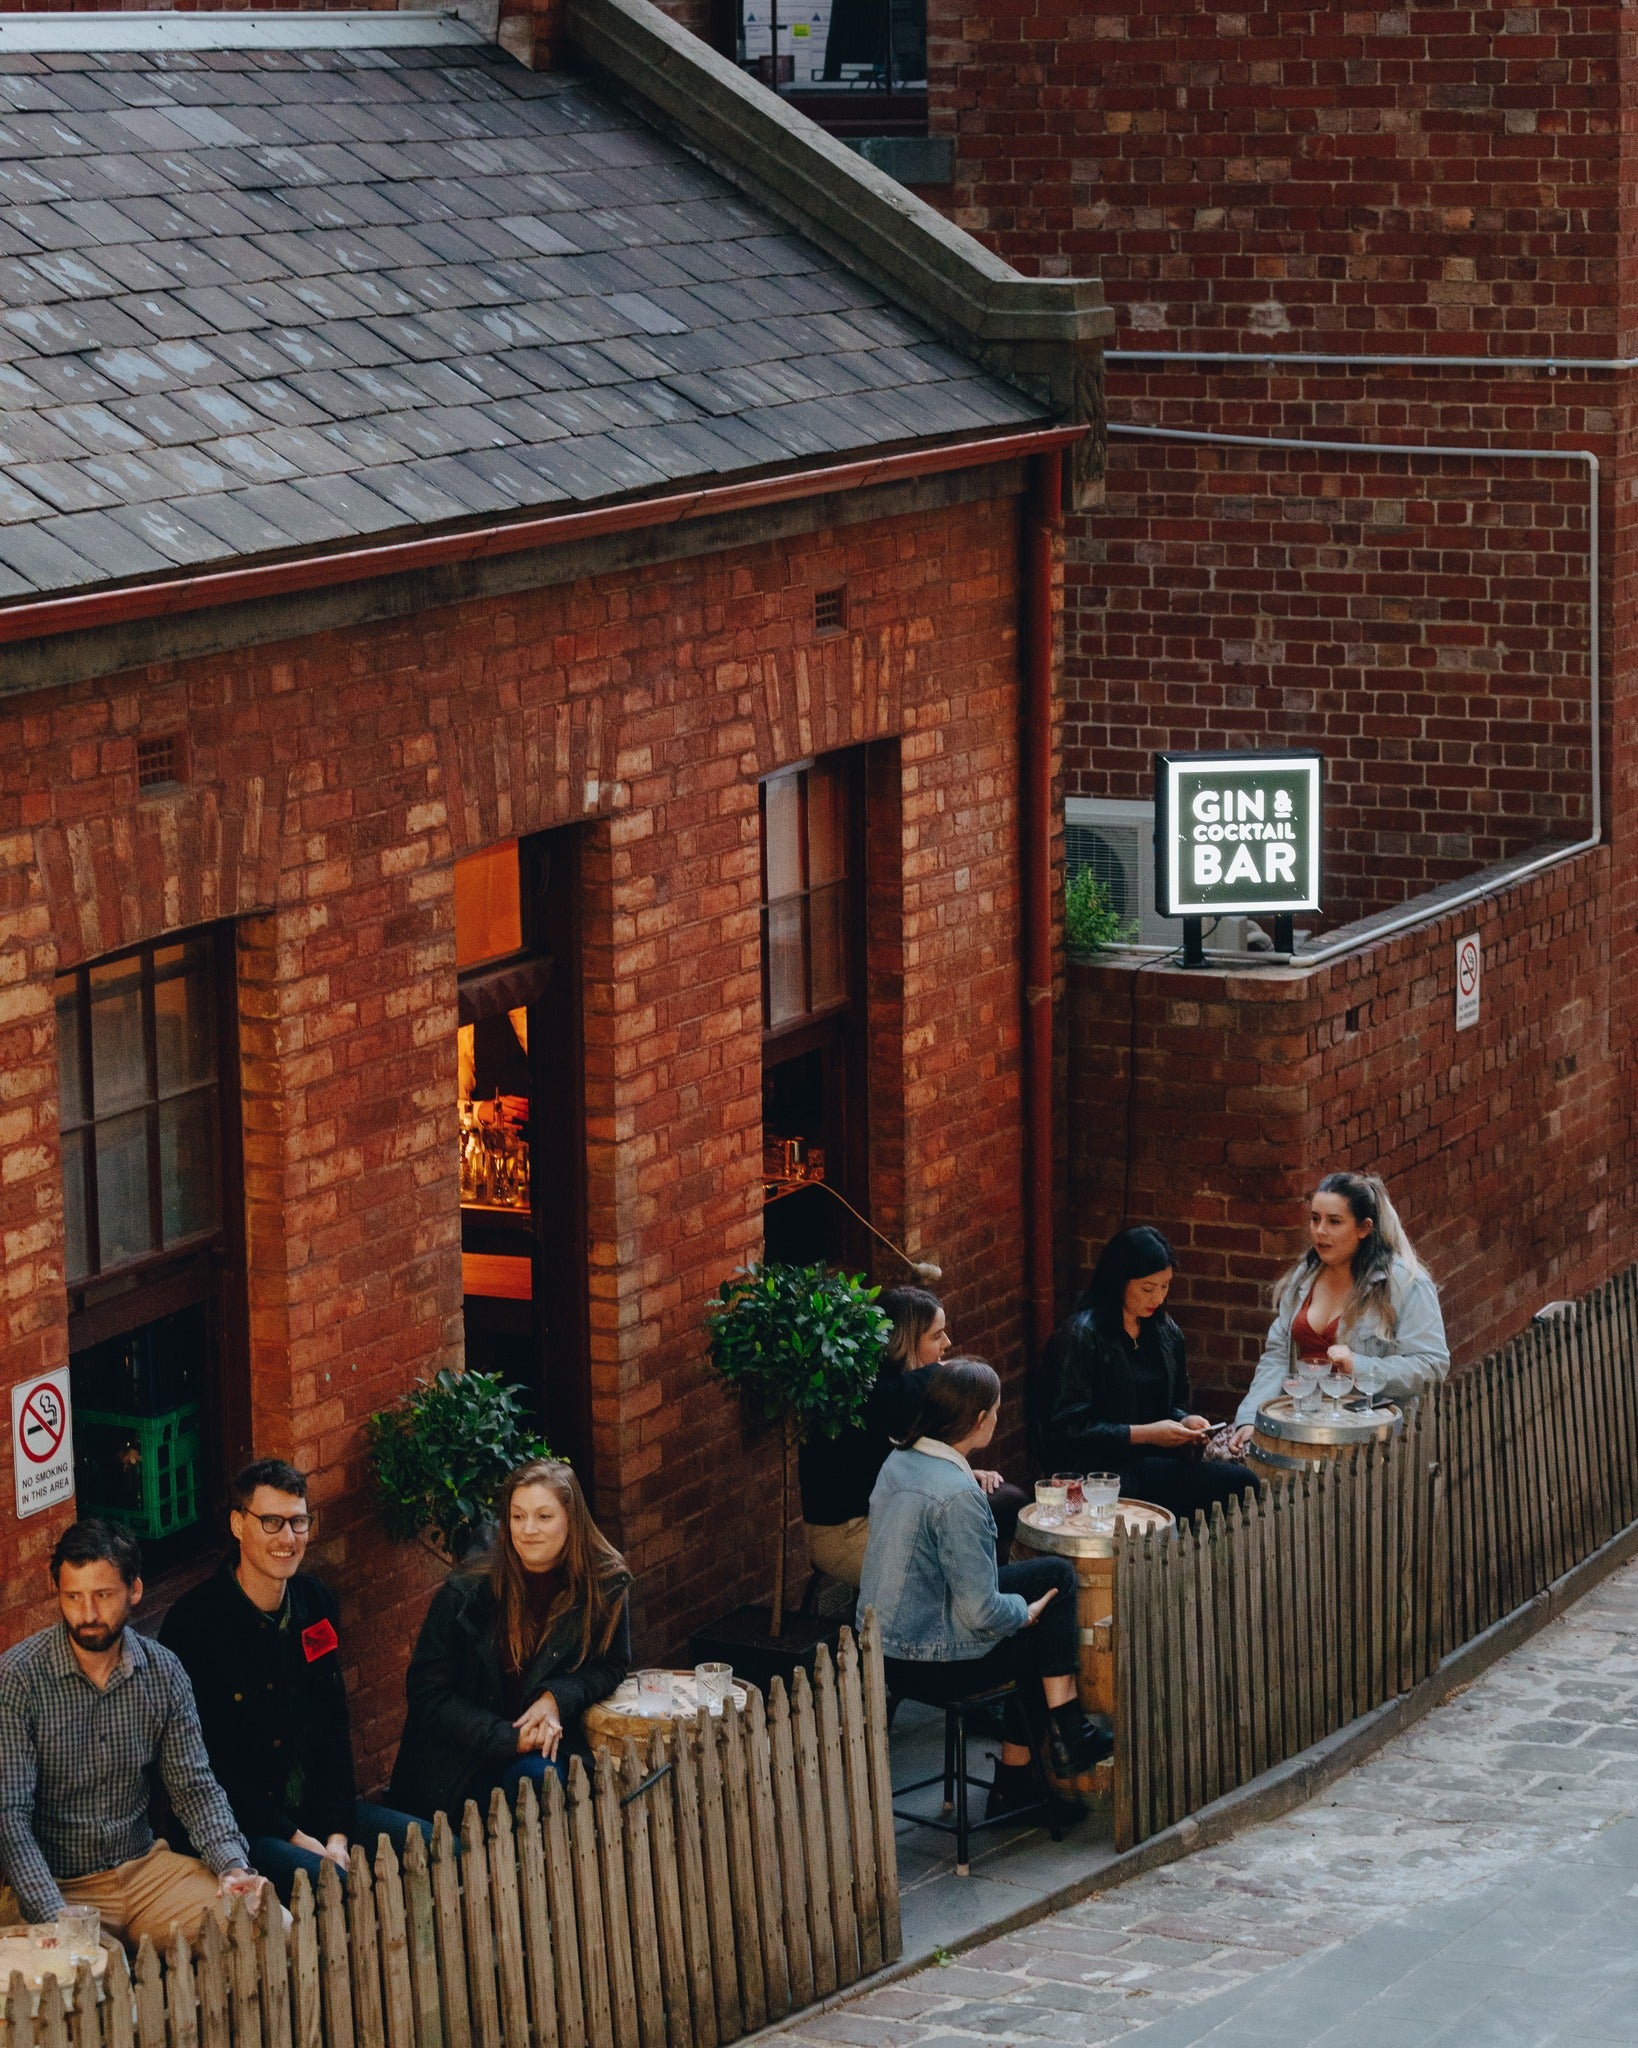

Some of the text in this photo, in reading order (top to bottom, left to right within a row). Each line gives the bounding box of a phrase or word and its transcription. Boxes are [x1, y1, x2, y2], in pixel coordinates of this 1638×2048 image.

[1192, 789, 1293, 823] GIN &
[1193, 822, 1296, 842] COCKTAIL
[1193, 842, 1297, 885] BAR
[22, 1462, 68, 1489] NO SMOKING
[21, 1476, 69, 1505] IN THIS AREA
